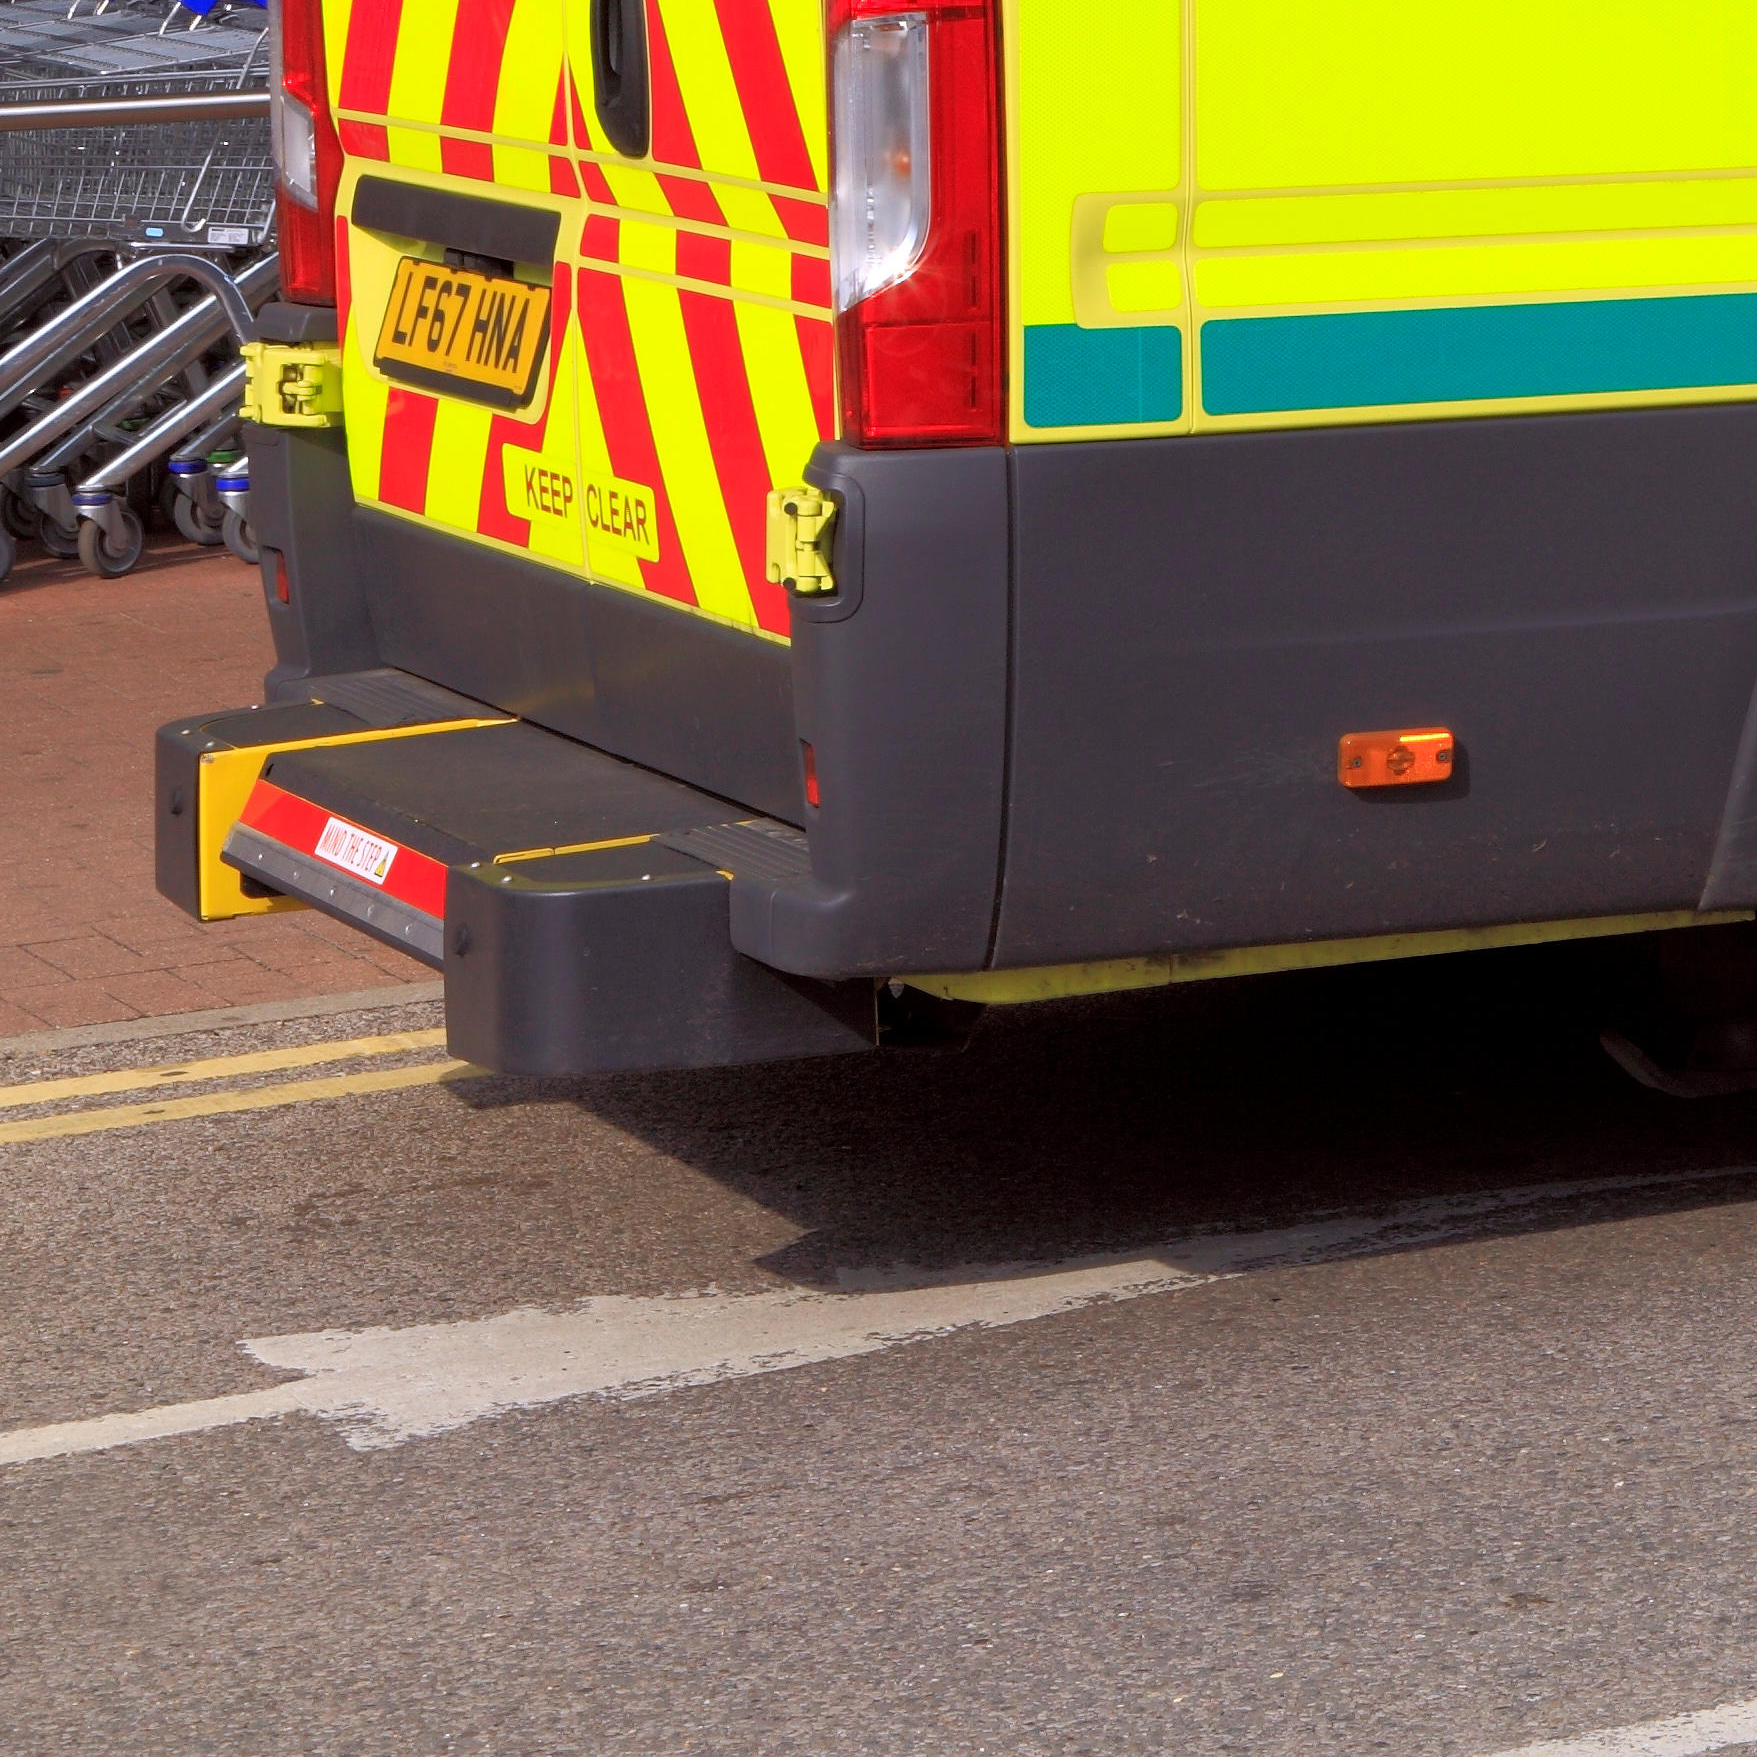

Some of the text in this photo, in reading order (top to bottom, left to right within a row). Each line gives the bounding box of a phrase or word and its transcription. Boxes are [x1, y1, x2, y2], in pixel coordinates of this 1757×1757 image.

[391, 271, 531, 374] LF67 HNA
[525, 464, 650, 545] KEEP CLEAR
[320, 823, 382, 872] MIND THE STEP
